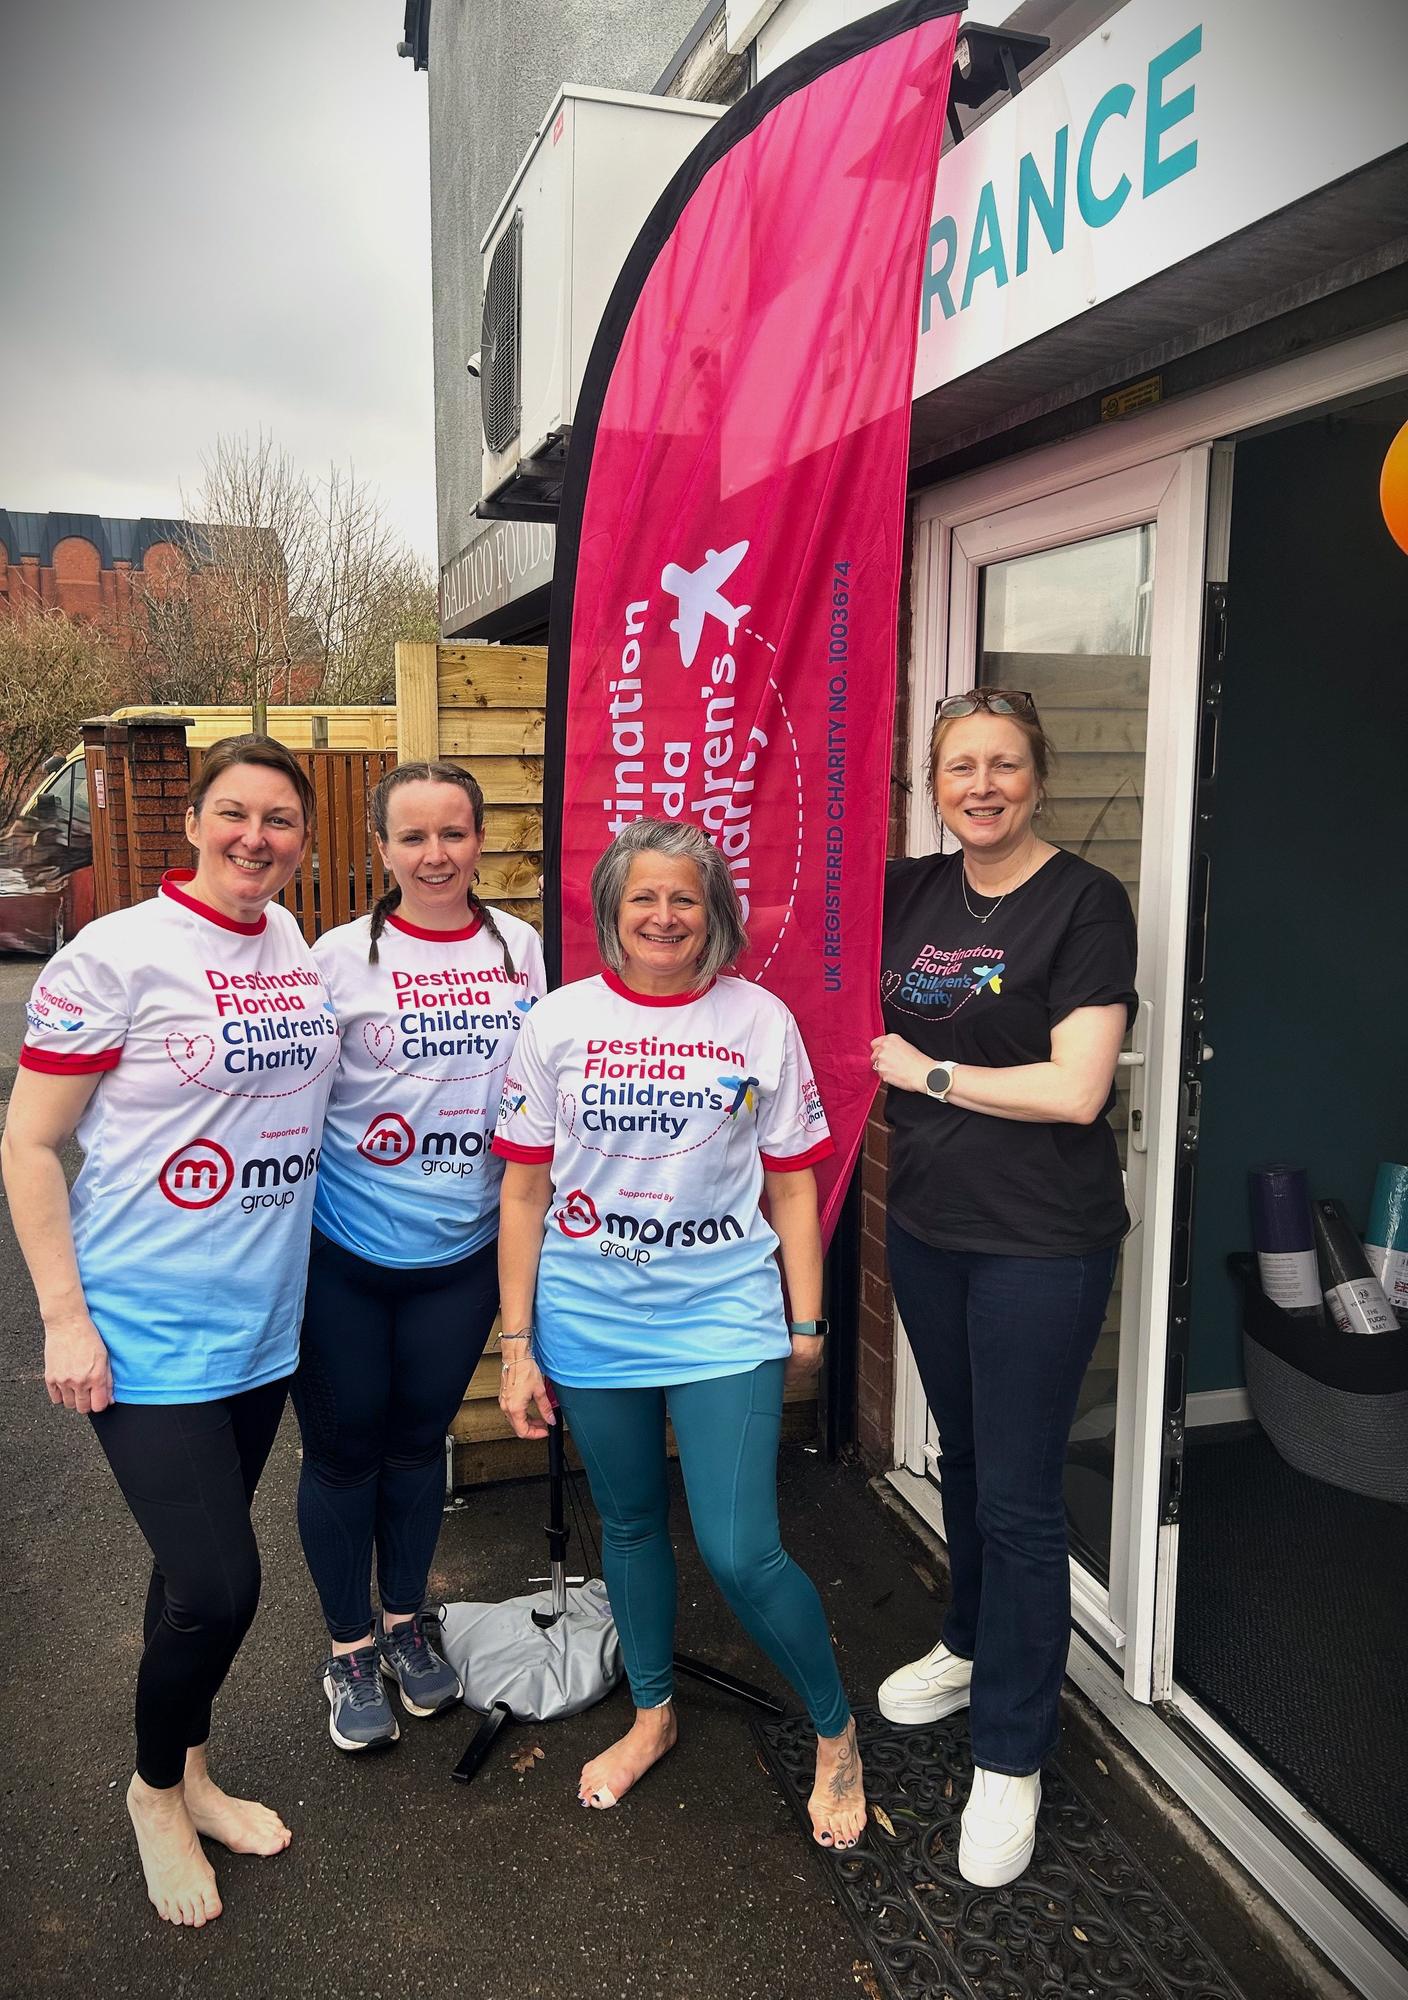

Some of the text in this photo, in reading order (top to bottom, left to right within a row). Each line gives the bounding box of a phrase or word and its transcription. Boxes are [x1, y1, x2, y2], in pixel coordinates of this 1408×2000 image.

[442, 538, 493, 621] BALTICO
[603, 599, 649, 838] tination
[691, 652, 737, 845] dren's
[824, 560, 852, 992] UK REGISTERED CHARITY NO. 1003674
[911, 956, 962, 976] Florida
[919, 943, 1005, 963] Destination
[214, 992, 306, 1017] Florida
[396, 987, 491, 1010] Florida
[222, 1013, 335, 1045] Children's
[400, 1009, 521, 1035] Children's
[224, 1041, 318, 1074] Charity
[402, 1032, 499, 1060] Charity
[587, 1036, 745, 1068] Destination
[584, 1057, 685, 1080] Florida
[581, 1082, 723, 1111] Children's
[438, 1108, 479, 1118] Supported
[582, 1108, 688, 1140] Charity
[260, 1125, 309, 1140] Supported By
[421, 1159, 473, 1178] group
[240, 1190, 295, 1214] group
[618, 1188, 675, 1203] Supported By
[605, 1212, 745, 1248] morson
[600, 1239, 650, 1267] group
